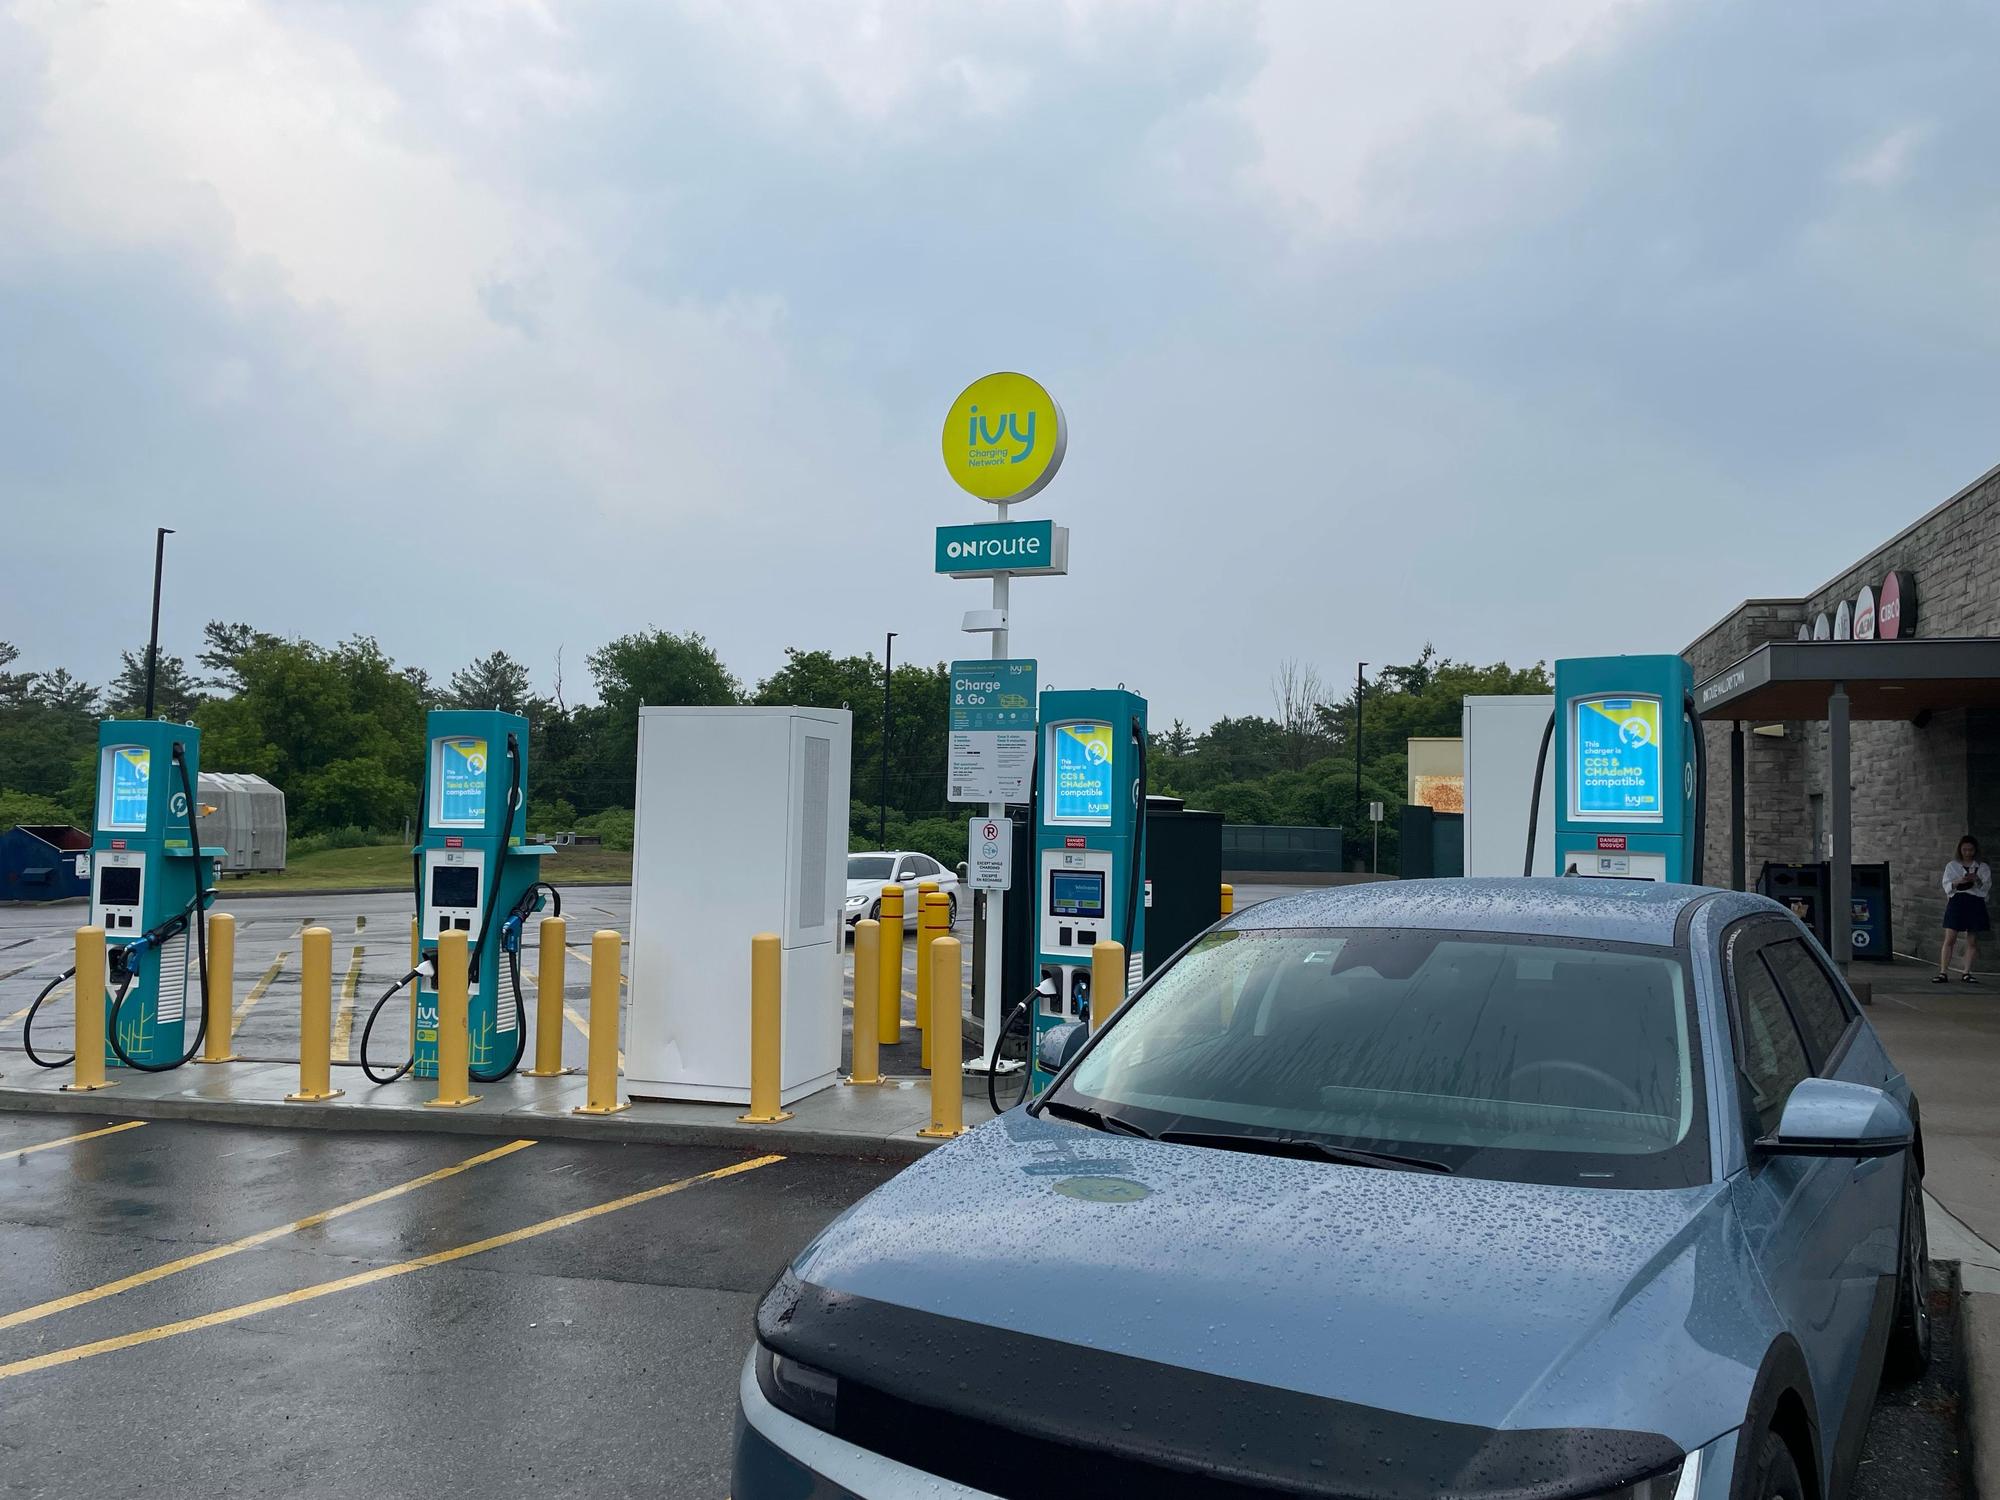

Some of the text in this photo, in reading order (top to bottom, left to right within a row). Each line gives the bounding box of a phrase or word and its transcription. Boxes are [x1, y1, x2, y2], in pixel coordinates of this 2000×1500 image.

[968, 405, 1036, 464] ivy
[969, 447, 1008, 459] Charging
[968, 456, 1005, 468] Network
[947, 536, 1041, 559] ONroute
[1009, 665, 1022, 675] ivy
[955, 679, 1001, 693] Charge
[955, 693, 986, 705] & Go
[1585, 740, 1600, 748] This
[1584, 747, 1622, 756] charger is
[1585, 757, 1620, 767] CCS &
[1585, 776, 1646, 788] compatible
[1060, 788, 1103, 798] compatible
[1625, 794, 1641, 806] ivy
[1088, 802, 1100, 813] ivy
